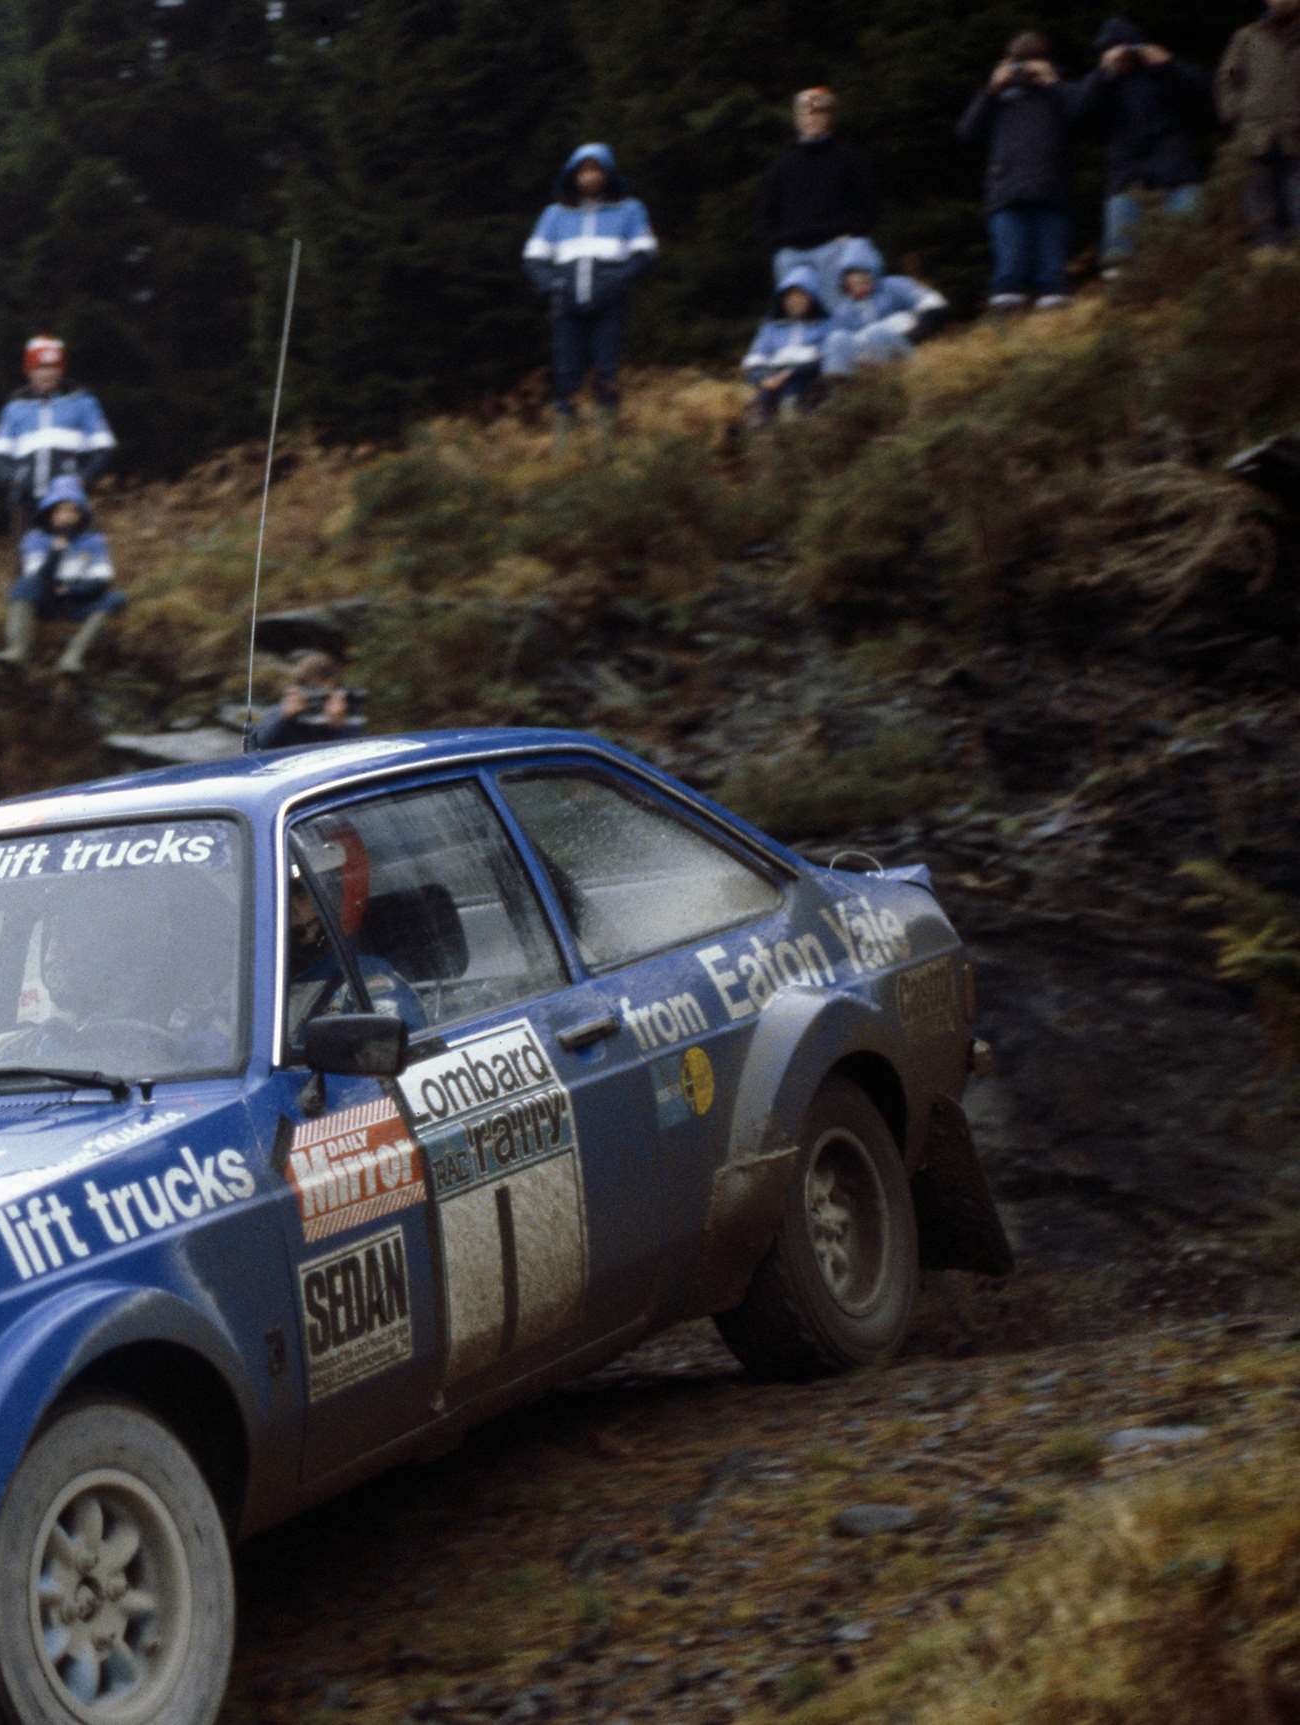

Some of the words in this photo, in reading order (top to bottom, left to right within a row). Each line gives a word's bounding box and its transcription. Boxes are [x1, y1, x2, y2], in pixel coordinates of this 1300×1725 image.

[61, 830, 215, 873] trucks
[619, 988, 708, 1050] from
[696, 936, 837, 1021] Eaton
[819, 896, 912, 975] Yale
[86, 1146, 257, 1245] trucks
[326, 1129, 368, 1158] DAILY
[303, 1240, 409, 1357] SEDAN
[494, 1184, 520, 1354] 1
